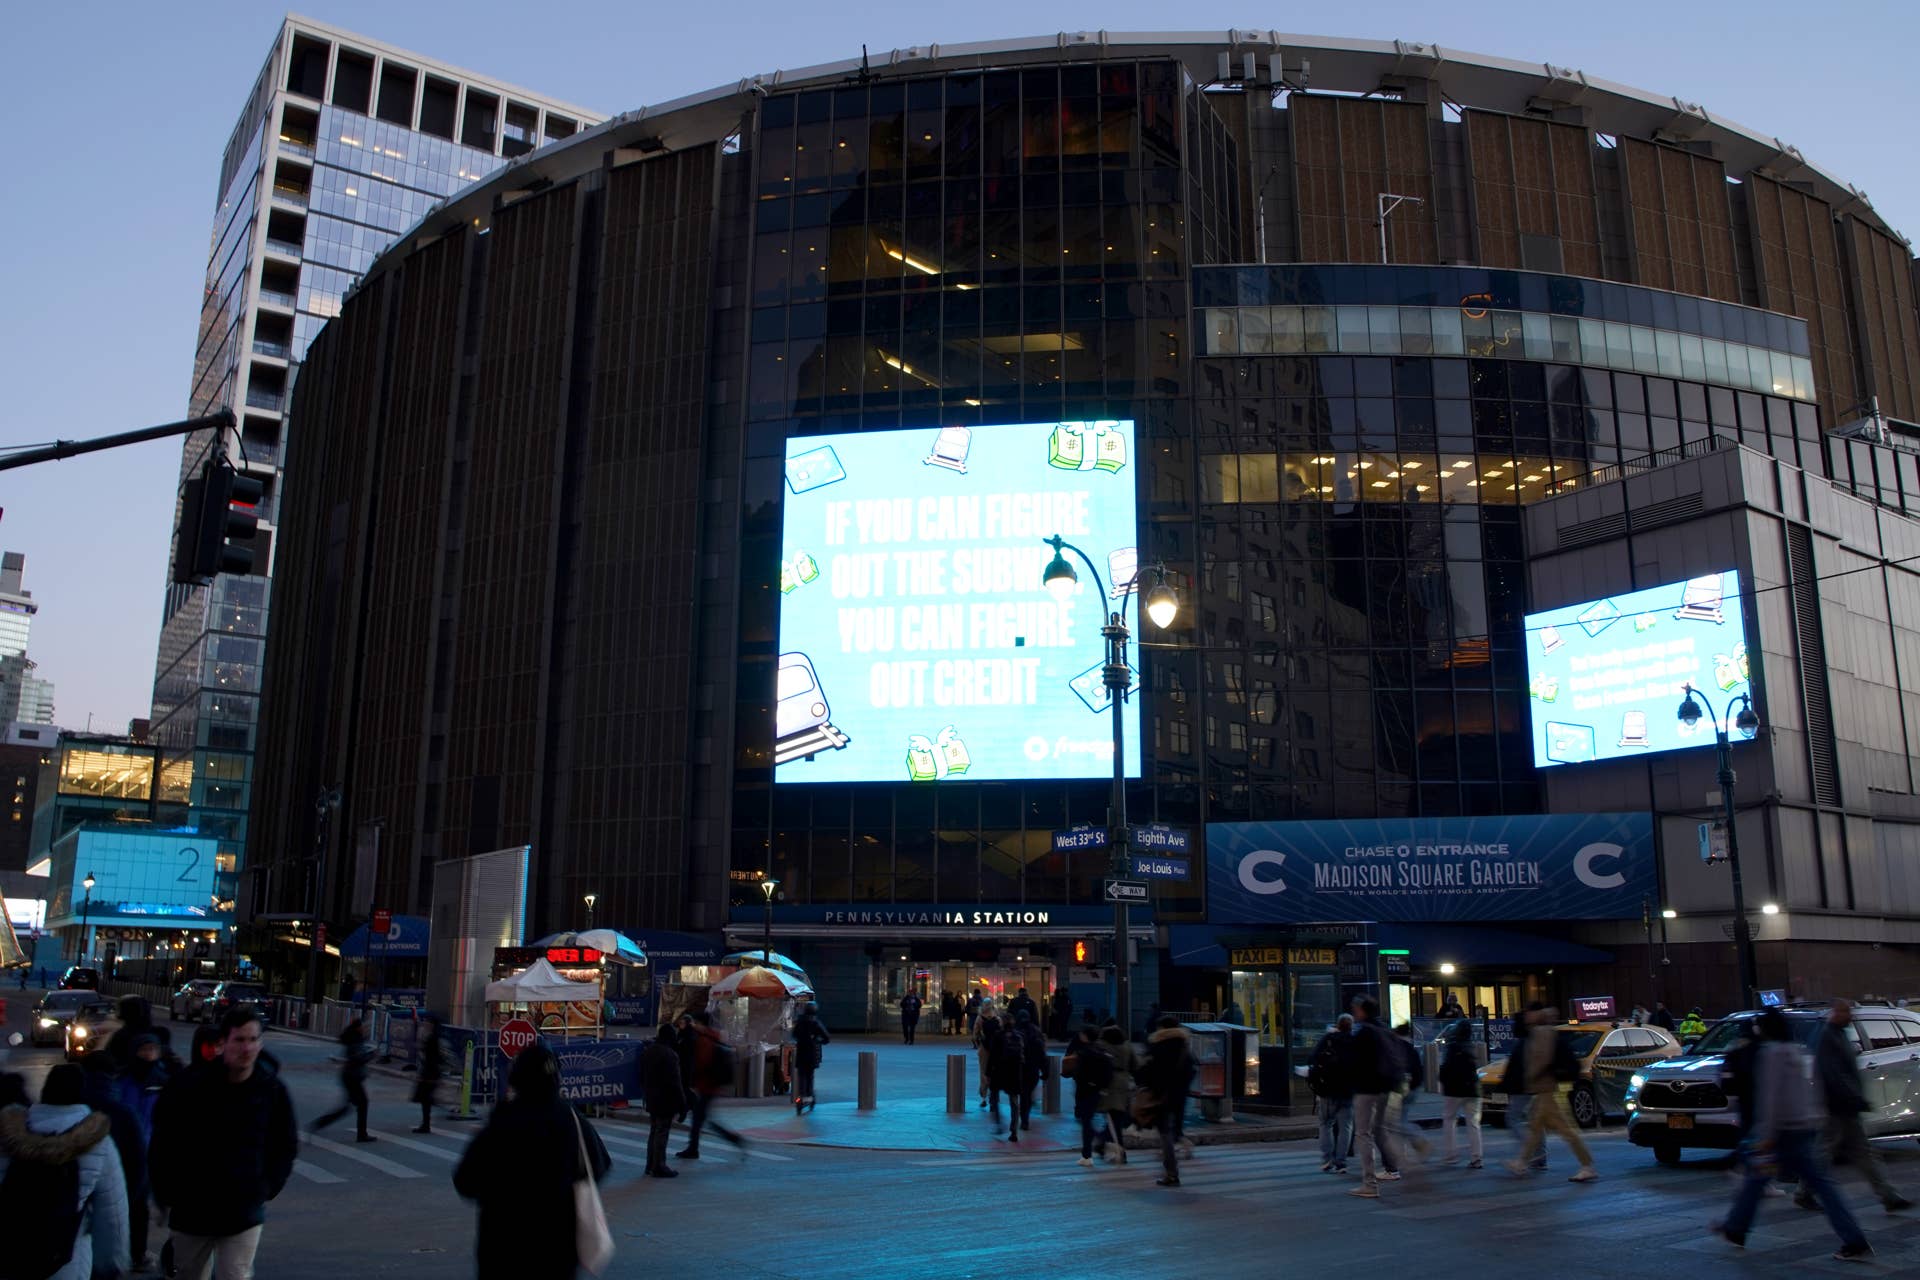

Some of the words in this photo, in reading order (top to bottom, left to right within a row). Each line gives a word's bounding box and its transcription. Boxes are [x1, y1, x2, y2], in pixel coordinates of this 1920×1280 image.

[825, 501, 852, 544] IF
[856, 498, 913, 542] YOU
[917, 495, 979, 540] CAN
[986, 491, 1089, 537] FIGURE
[831, 552, 889, 599] OUT
[893, 550, 944, 596] THE
[837, 605, 895, 653] YOU
[900, 603, 964, 649] CAN
[969, 600, 1076, 649] FIGURE
[869, 659, 929, 708] OUT
[933, 657, 1041, 707] CREDIT
[1056, 834, 1077, 848] West
[1078, 832, 1094, 845] 33rd
[1096, 831, 1105, 844] St
[1137, 831, 1166, 846] Eighth
[1168, 833, 1185, 846] Ave
[1345, 846, 1395, 858] CHASE
[1416, 843, 1510, 857] ENTRANCE
[176, 847, 200, 882] 2
[1137, 860, 1151, 873] Joe
[1152, 861, 1172, 875] Louis
[1237, 849, 1287, 895] C
[1572, 842, 1627, 889] C
[1111, 884, 1125, 895] ONE
[1129, 885, 1143, 894] WAY
[825, 911, 964, 925] PENNSYLVANIA
[973, 911, 1049, 924] STATION
[1234, 948, 1265, 963] TAXI
[1290, 947, 1320, 963] TAXI
[501, 1030, 536, 1047] STOP
[592, 1074, 604, 1083] TO
[559, 1083, 624, 1099] GARDEN
